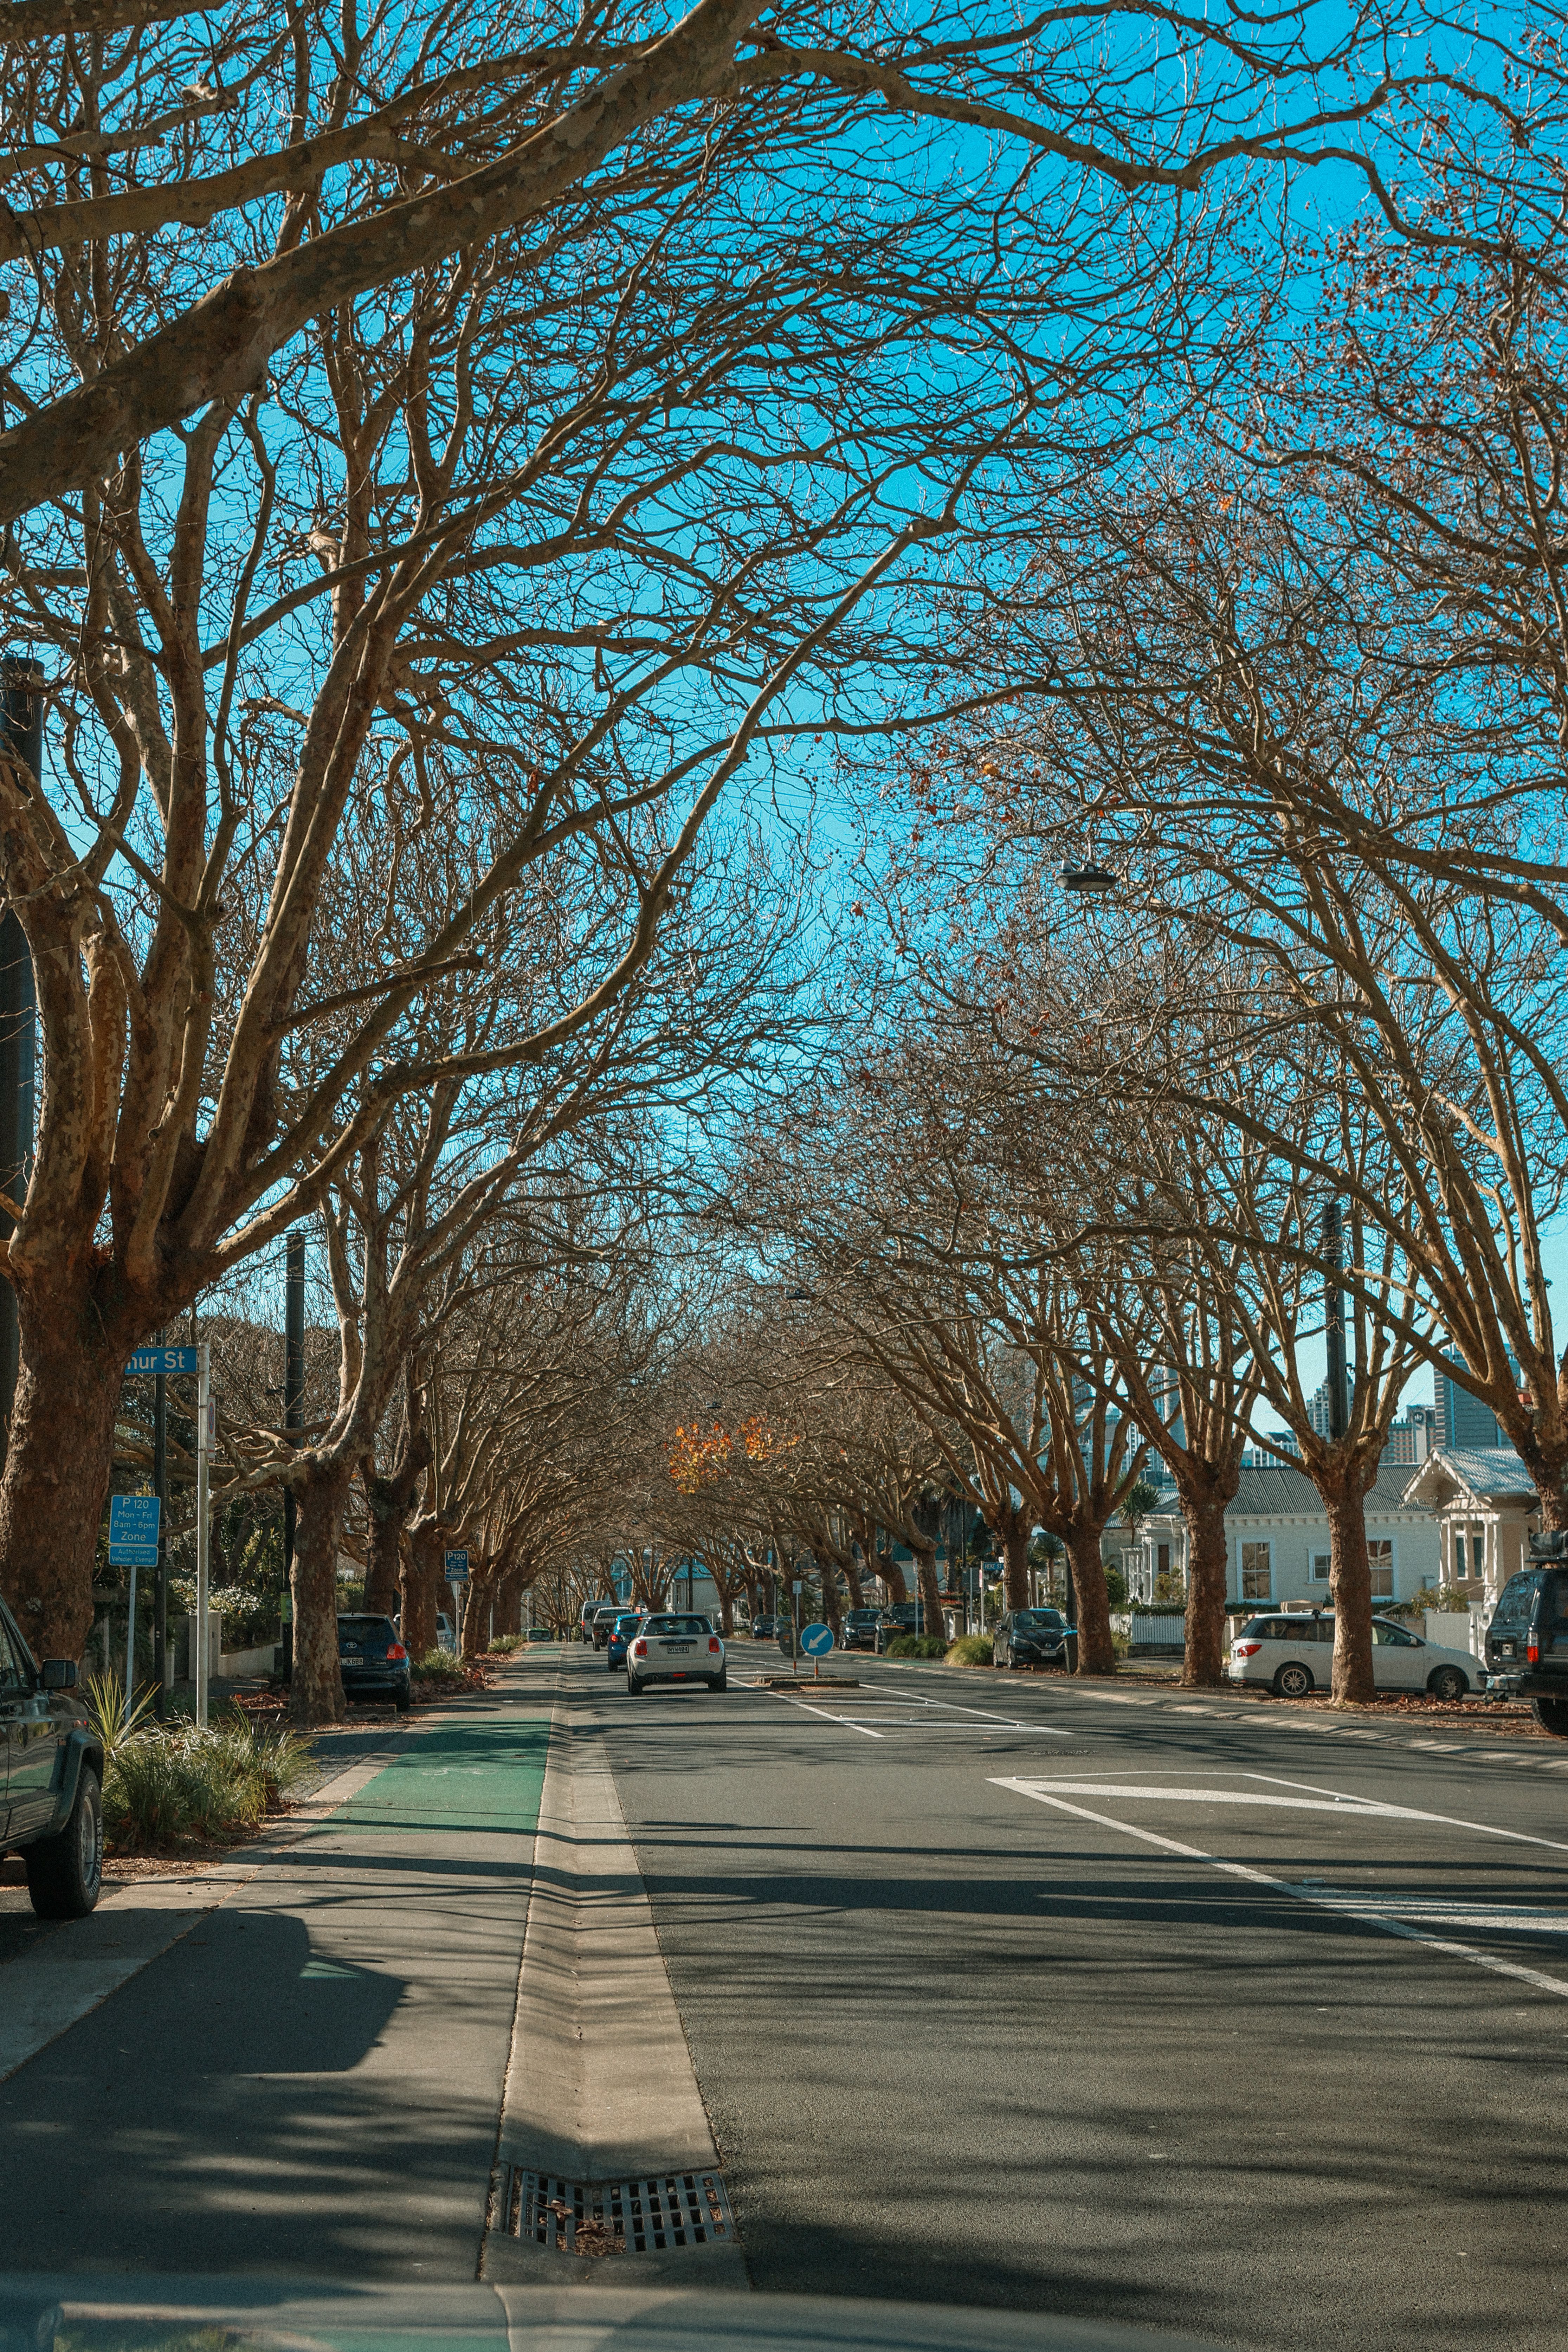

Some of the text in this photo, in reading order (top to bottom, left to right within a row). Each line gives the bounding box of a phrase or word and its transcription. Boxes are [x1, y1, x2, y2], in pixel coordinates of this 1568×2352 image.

[164, 1351, 185, 1369] St
[123, 1498, 149, 1509] P 120
[138, 1521, 155, 1530] 6pm
[121, 1531, 146, 1541] Zone
